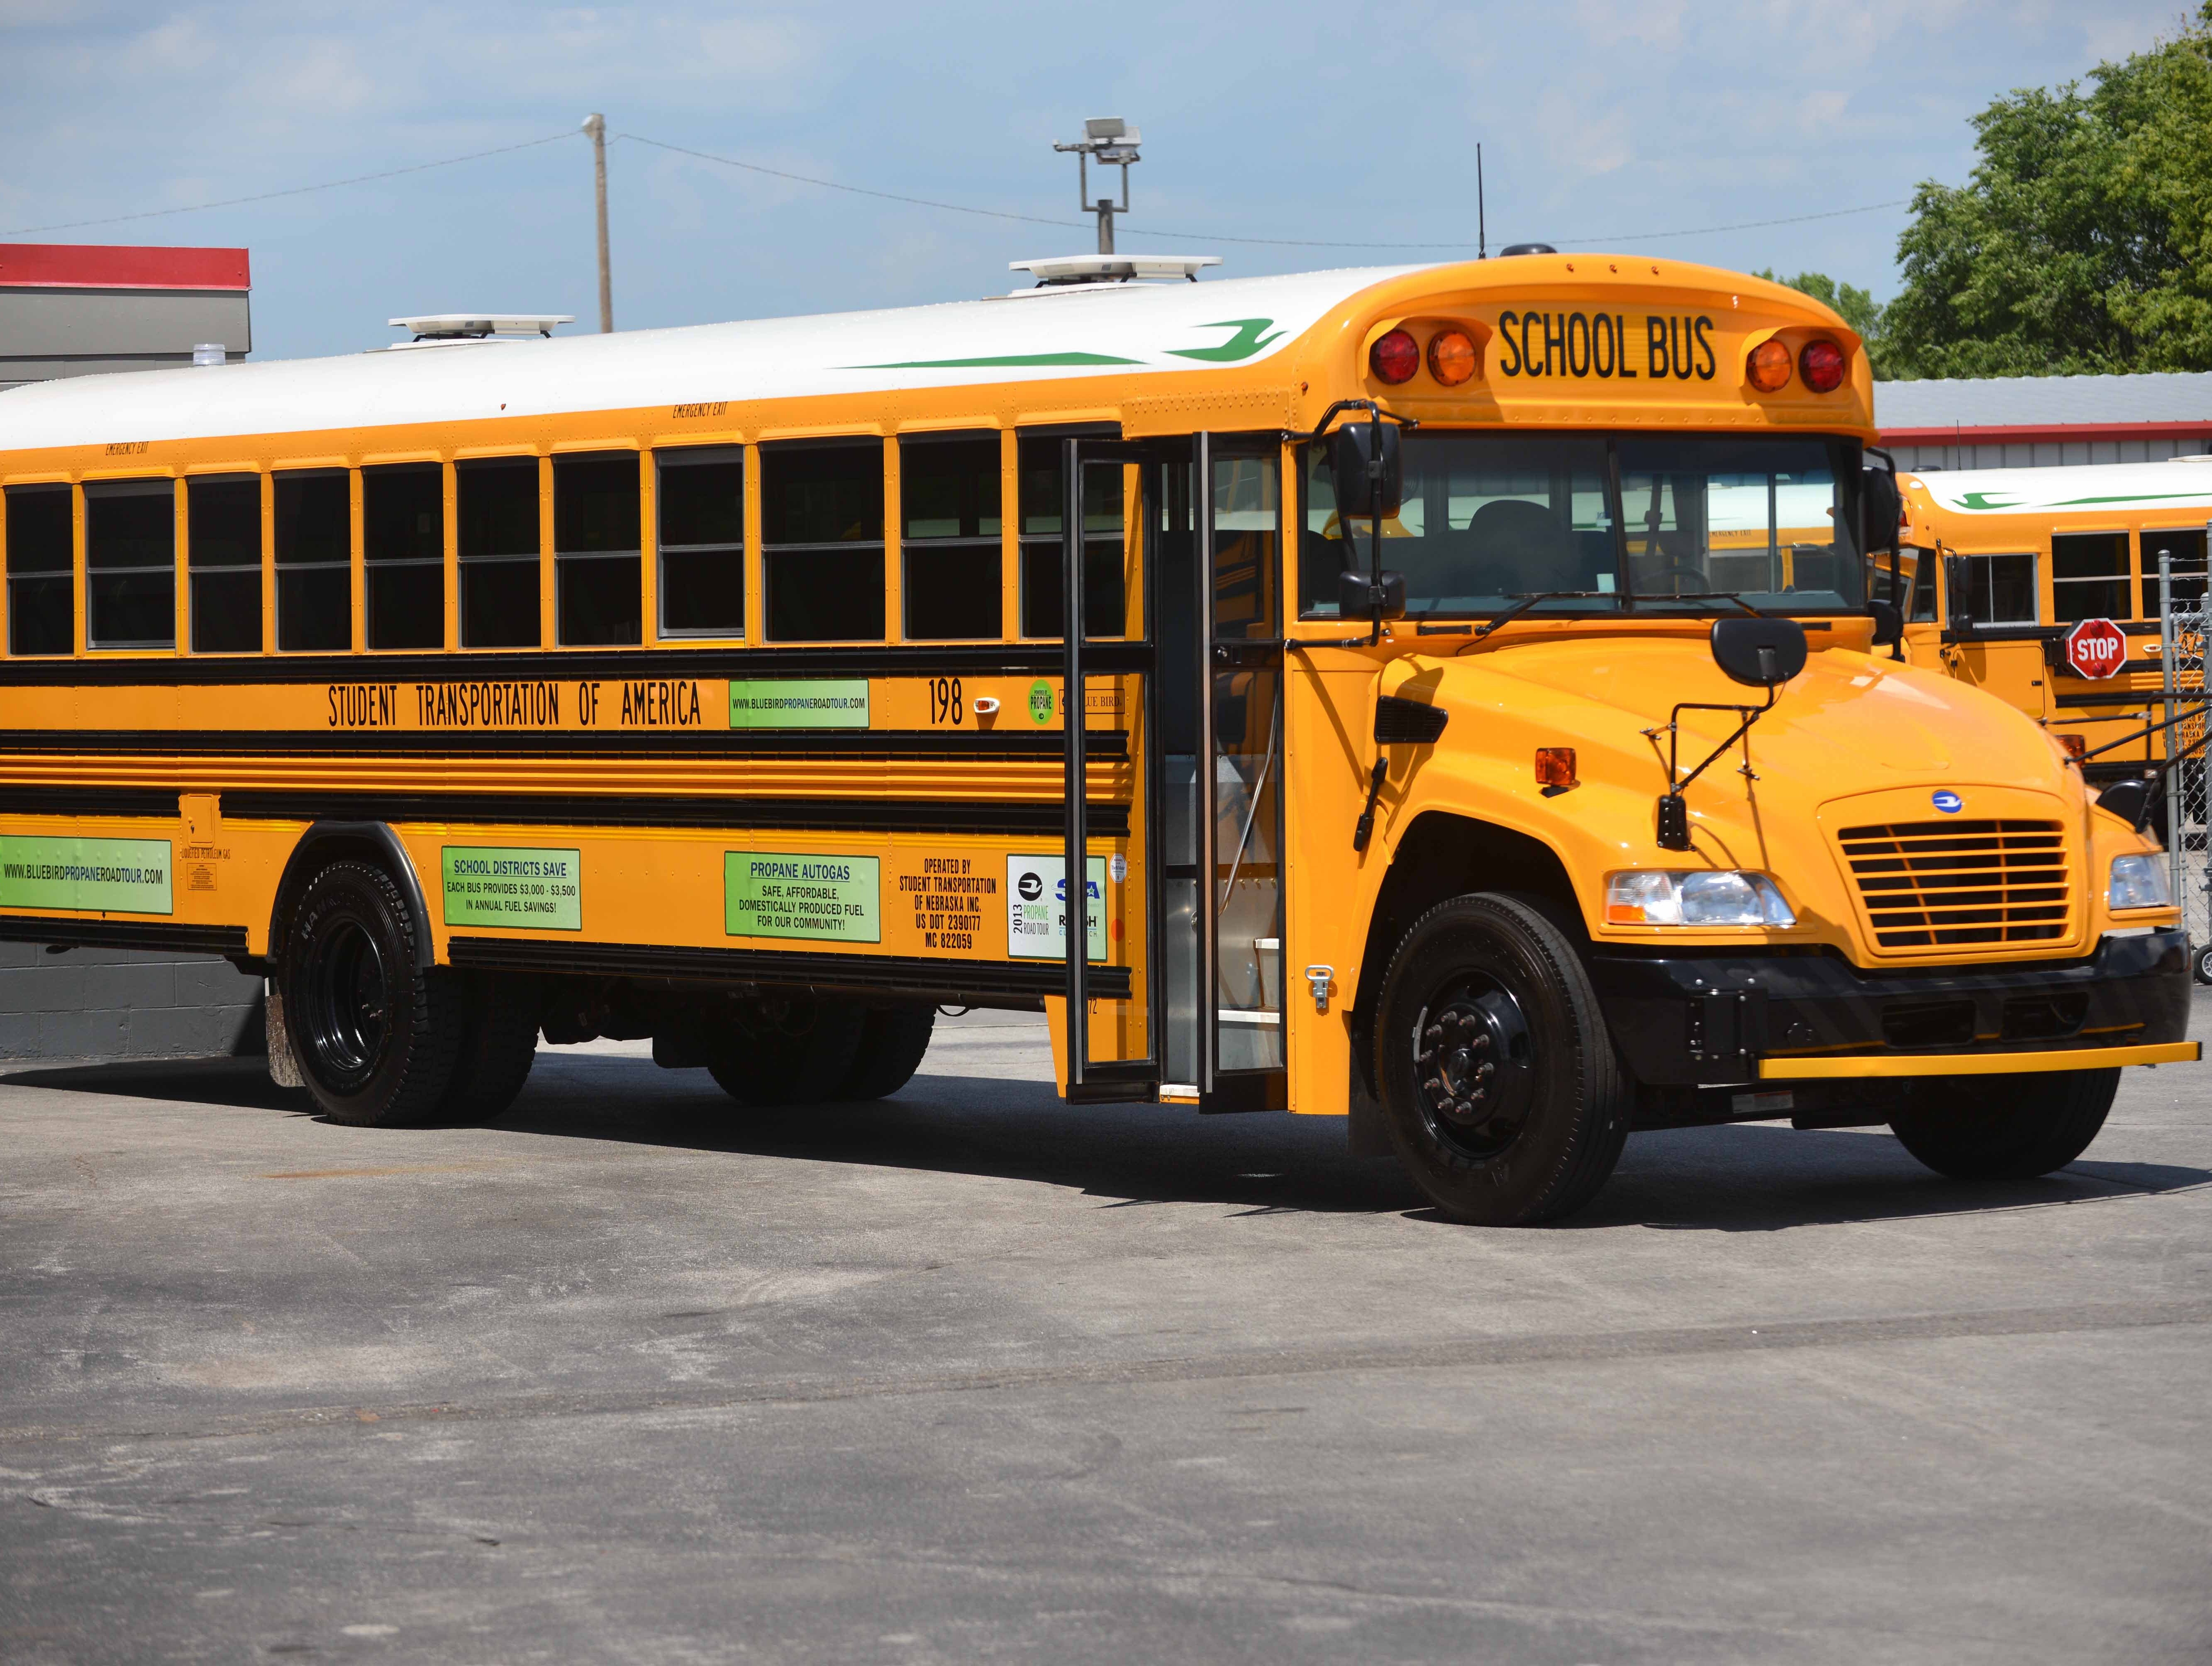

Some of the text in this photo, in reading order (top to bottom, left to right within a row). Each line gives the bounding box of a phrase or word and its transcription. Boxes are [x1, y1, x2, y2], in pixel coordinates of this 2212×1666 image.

[1499, 310, 1716, 380] SCHOOL BUS
[673, 401, 728, 419] EMERGENCY EXIT
[105, 441, 149, 456] EMERGENCY EXIT
[2077, 637, 2118, 661] STOP
[329, 680, 701, 727] STUDENT TRANSPORTATION OF AMERICA
[732, 697, 865, 709] WWW.BLUEBIRDPROPANEROADTOUR.COM
[929, 677, 963, 725] 198
[1030, 696, 1052, 710] PROPANE
[1100, 696, 1119, 706] BIRD
[4, 863, 163, 884] WWW.BLUEBIRDPROPANEROADTOUR.COM
[454, 860, 567, 877] SCHOOL DISTRICTS SAVE
[750, 862, 850, 880] PROPANE AUTOGAS
[924, 858, 971, 874] OPERATED BY
[447, 882, 465, 893] EACH
[467, 882, 481, 893] BUS
[483, 883, 518, 894] PROVIDES
[520, 883, 544, 896] $3,000
[551, 884, 576, 898] $3,500
[762, 885, 839, 901] SAFE, AFFORDABLE,
[900, 875, 996, 894] STUDENT TRANSPORTATION
[466, 899, 556, 913] IN ANNUAL FUEL SAVINGS!
[739, 899, 864, 916] DOMESTICALLY PRODUCED FUEL
[915, 894, 981, 913] OF NEBRASKA INC.
[1024, 904, 1049, 920] PROPANE
[757, 915, 845, 930] FOR OUR COMMUNITY!
[916, 913, 980, 931] US DOT 2390177
[1012, 904, 1023, 934] 2013
[1059, 914, 1097, 927] RH
[1024, 922, 1036, 935] ROAD
[1036, 923, 1049, 935] TOUR
[925, 932, 972, 949] MC 822059
